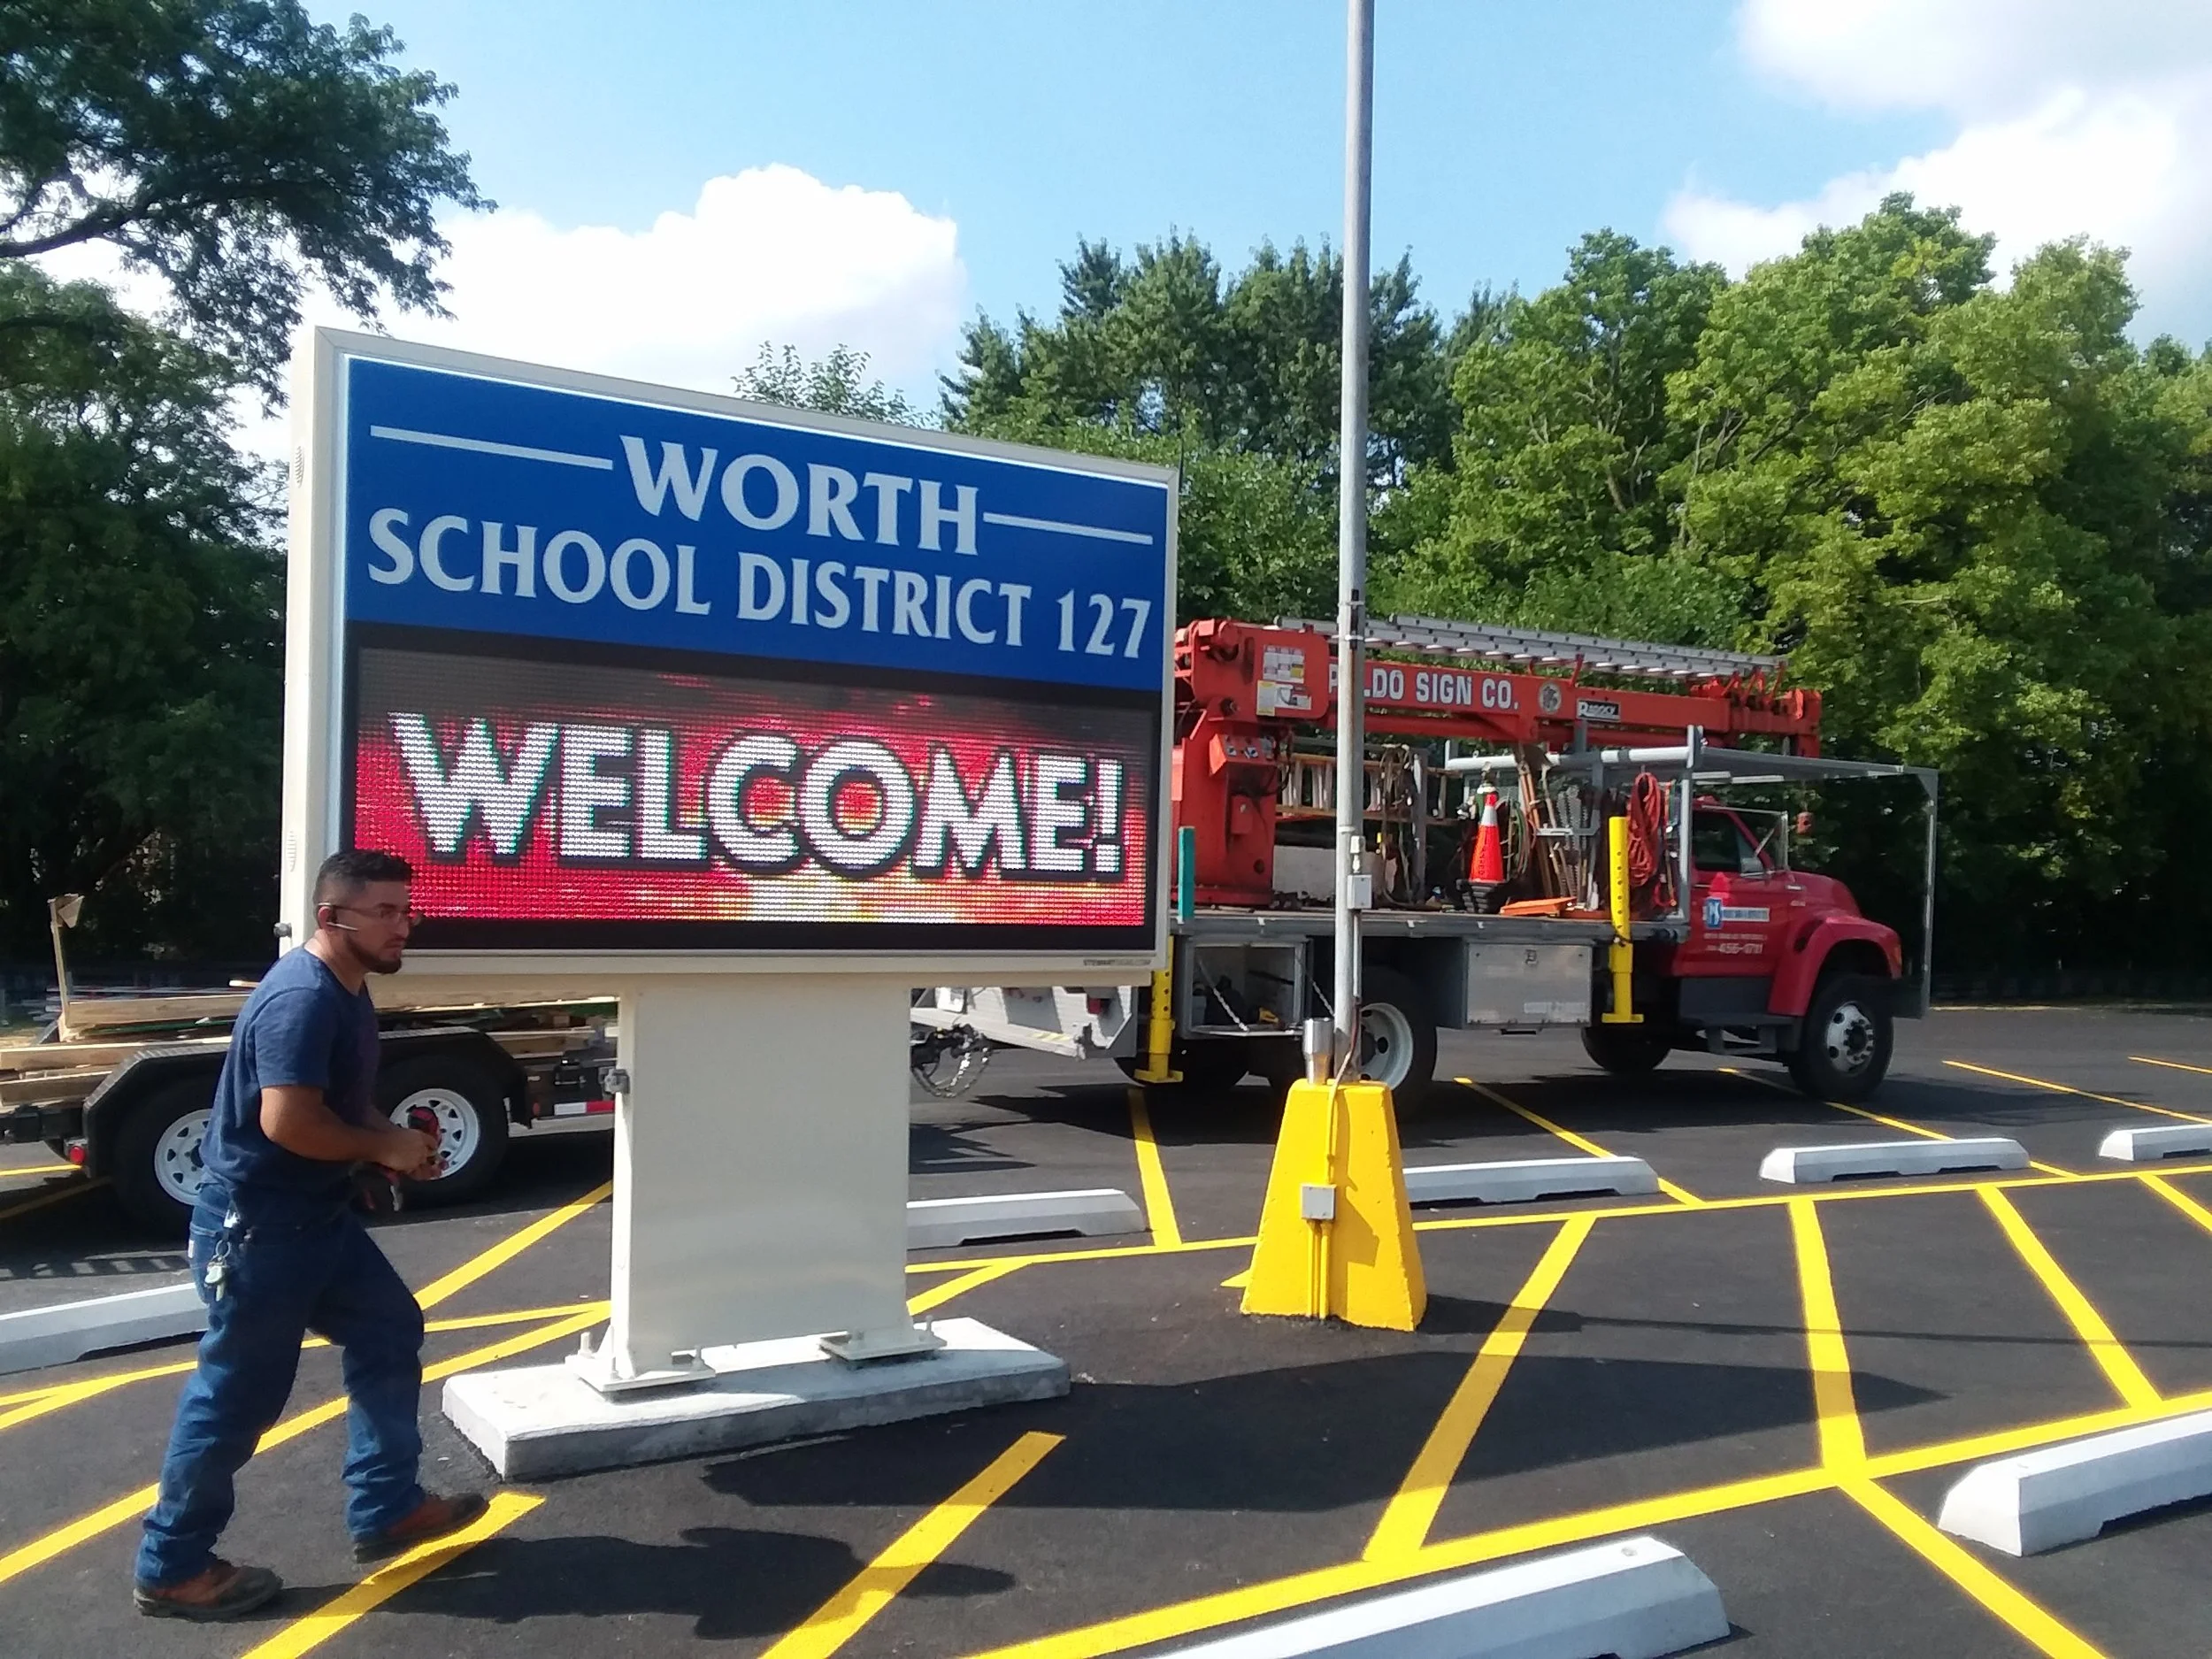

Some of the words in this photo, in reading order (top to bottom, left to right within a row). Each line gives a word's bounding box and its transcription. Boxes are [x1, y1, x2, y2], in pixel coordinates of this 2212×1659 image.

[620, 435, 979, 555] WORTH
[368, 508, 711, 616] SCHOOL
[737, 552, 1033, 647] DISTRICT
[1057, 591, 1151, 659] 127
[1416, 672, 1472, 706] SIGN
[1482, 678, 1519, 710] CO.
[388, 711, 1125, 874] WELCOME!
